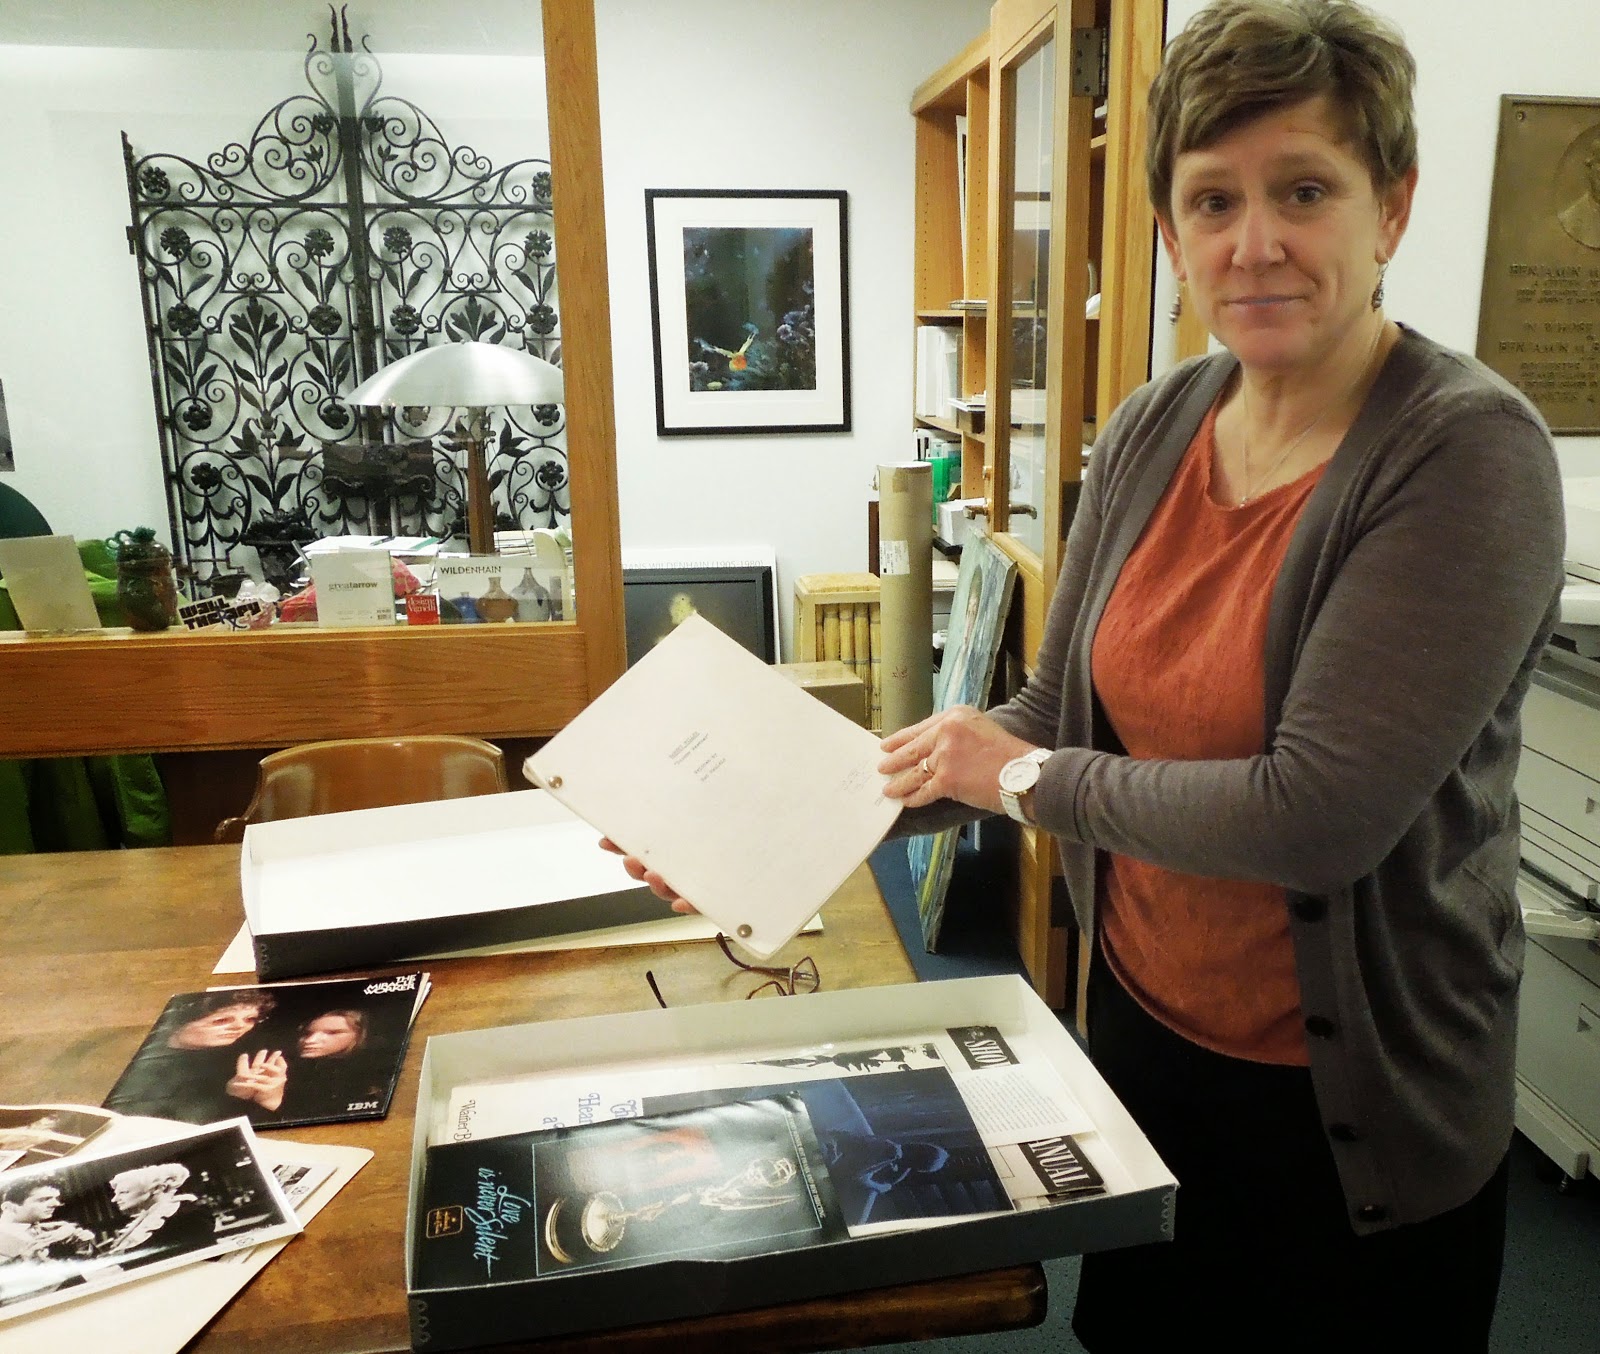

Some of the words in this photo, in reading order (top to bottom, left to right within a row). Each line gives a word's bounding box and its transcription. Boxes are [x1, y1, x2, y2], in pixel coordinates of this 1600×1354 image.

[440, 565, 501, 575] WILDENHAIN
[396, 974, 417, 983] THE
[347, 1101, 379, 1111] IBM
[457, 1099, 477, 1132] Warner
[578, 1092, 601, 1124] Hear
[612, 1099, 637, 1119] Th
[453, 1132, 472, 1142] B
[478, 1167, 501, 1180] is
[1028, 1137, 1091, 1187] ANUAL
[477, 1181, 496, 1218] never
[496, 1185, 532, 1224] Love
[463, 1207, 508, 1278] Silent
